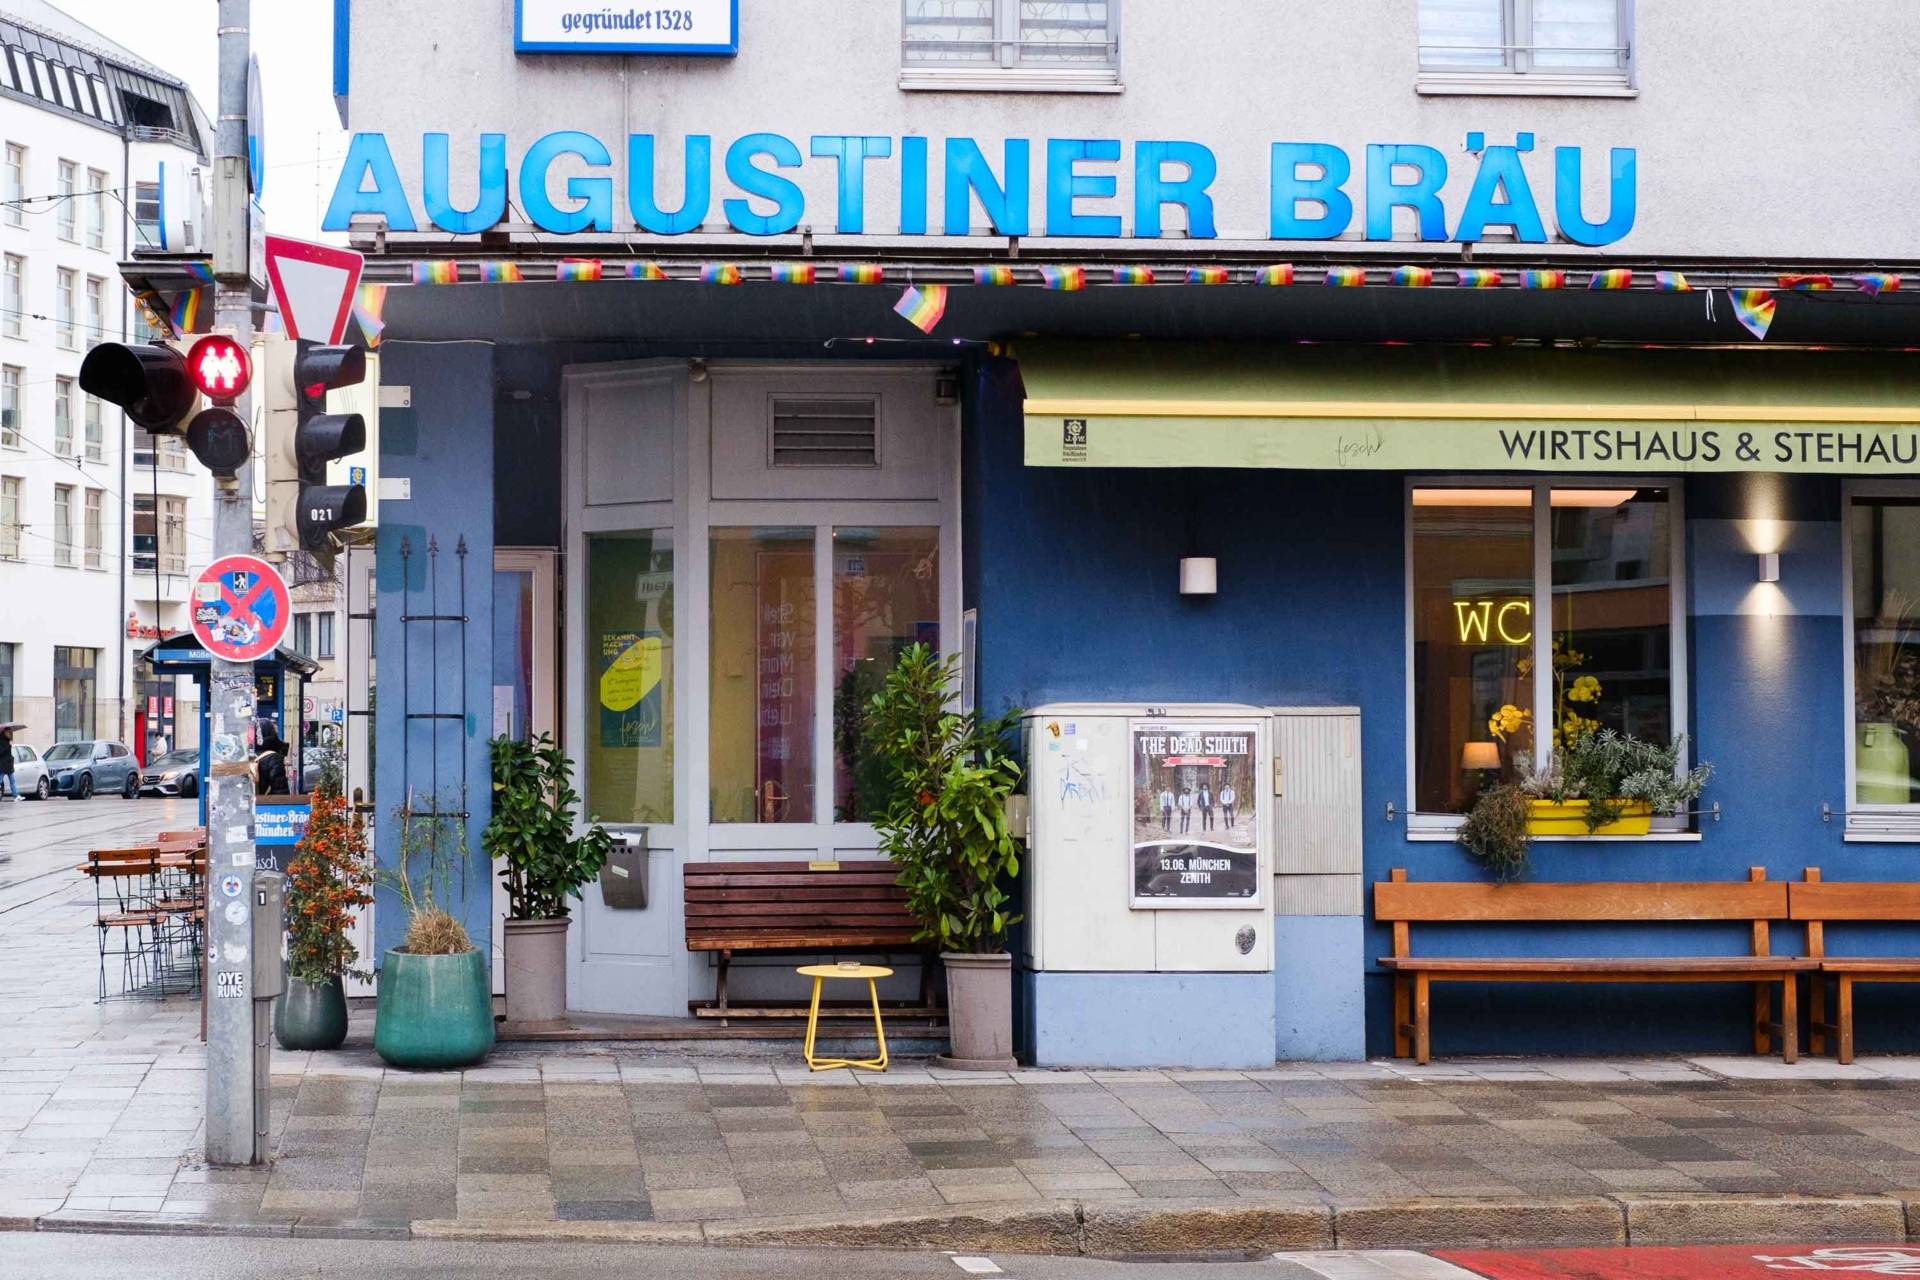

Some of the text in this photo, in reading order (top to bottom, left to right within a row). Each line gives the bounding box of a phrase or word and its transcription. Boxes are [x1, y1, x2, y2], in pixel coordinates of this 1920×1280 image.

[562, 9, 693, 34] gegründet 1328
[322, 131, 1637, 246] AUGUSTINER BRÄU
[1499, 430, 1720, 462] WIRTSHAUS
[1735, 432, 1760, 462] &
[311, 508, 332, 521] 021
[1453, 601, 1531, 643] WC
[1140, 737, 1248, 754] THE DEAD SOUTH
[1160, 857, 1231, 871] 13.06. MÜNCHEN
[1180, 872, 1211, 884] ZENITH
[217, 972, 243, 985] OYE
[217, 985, 243, 998] RUNS
